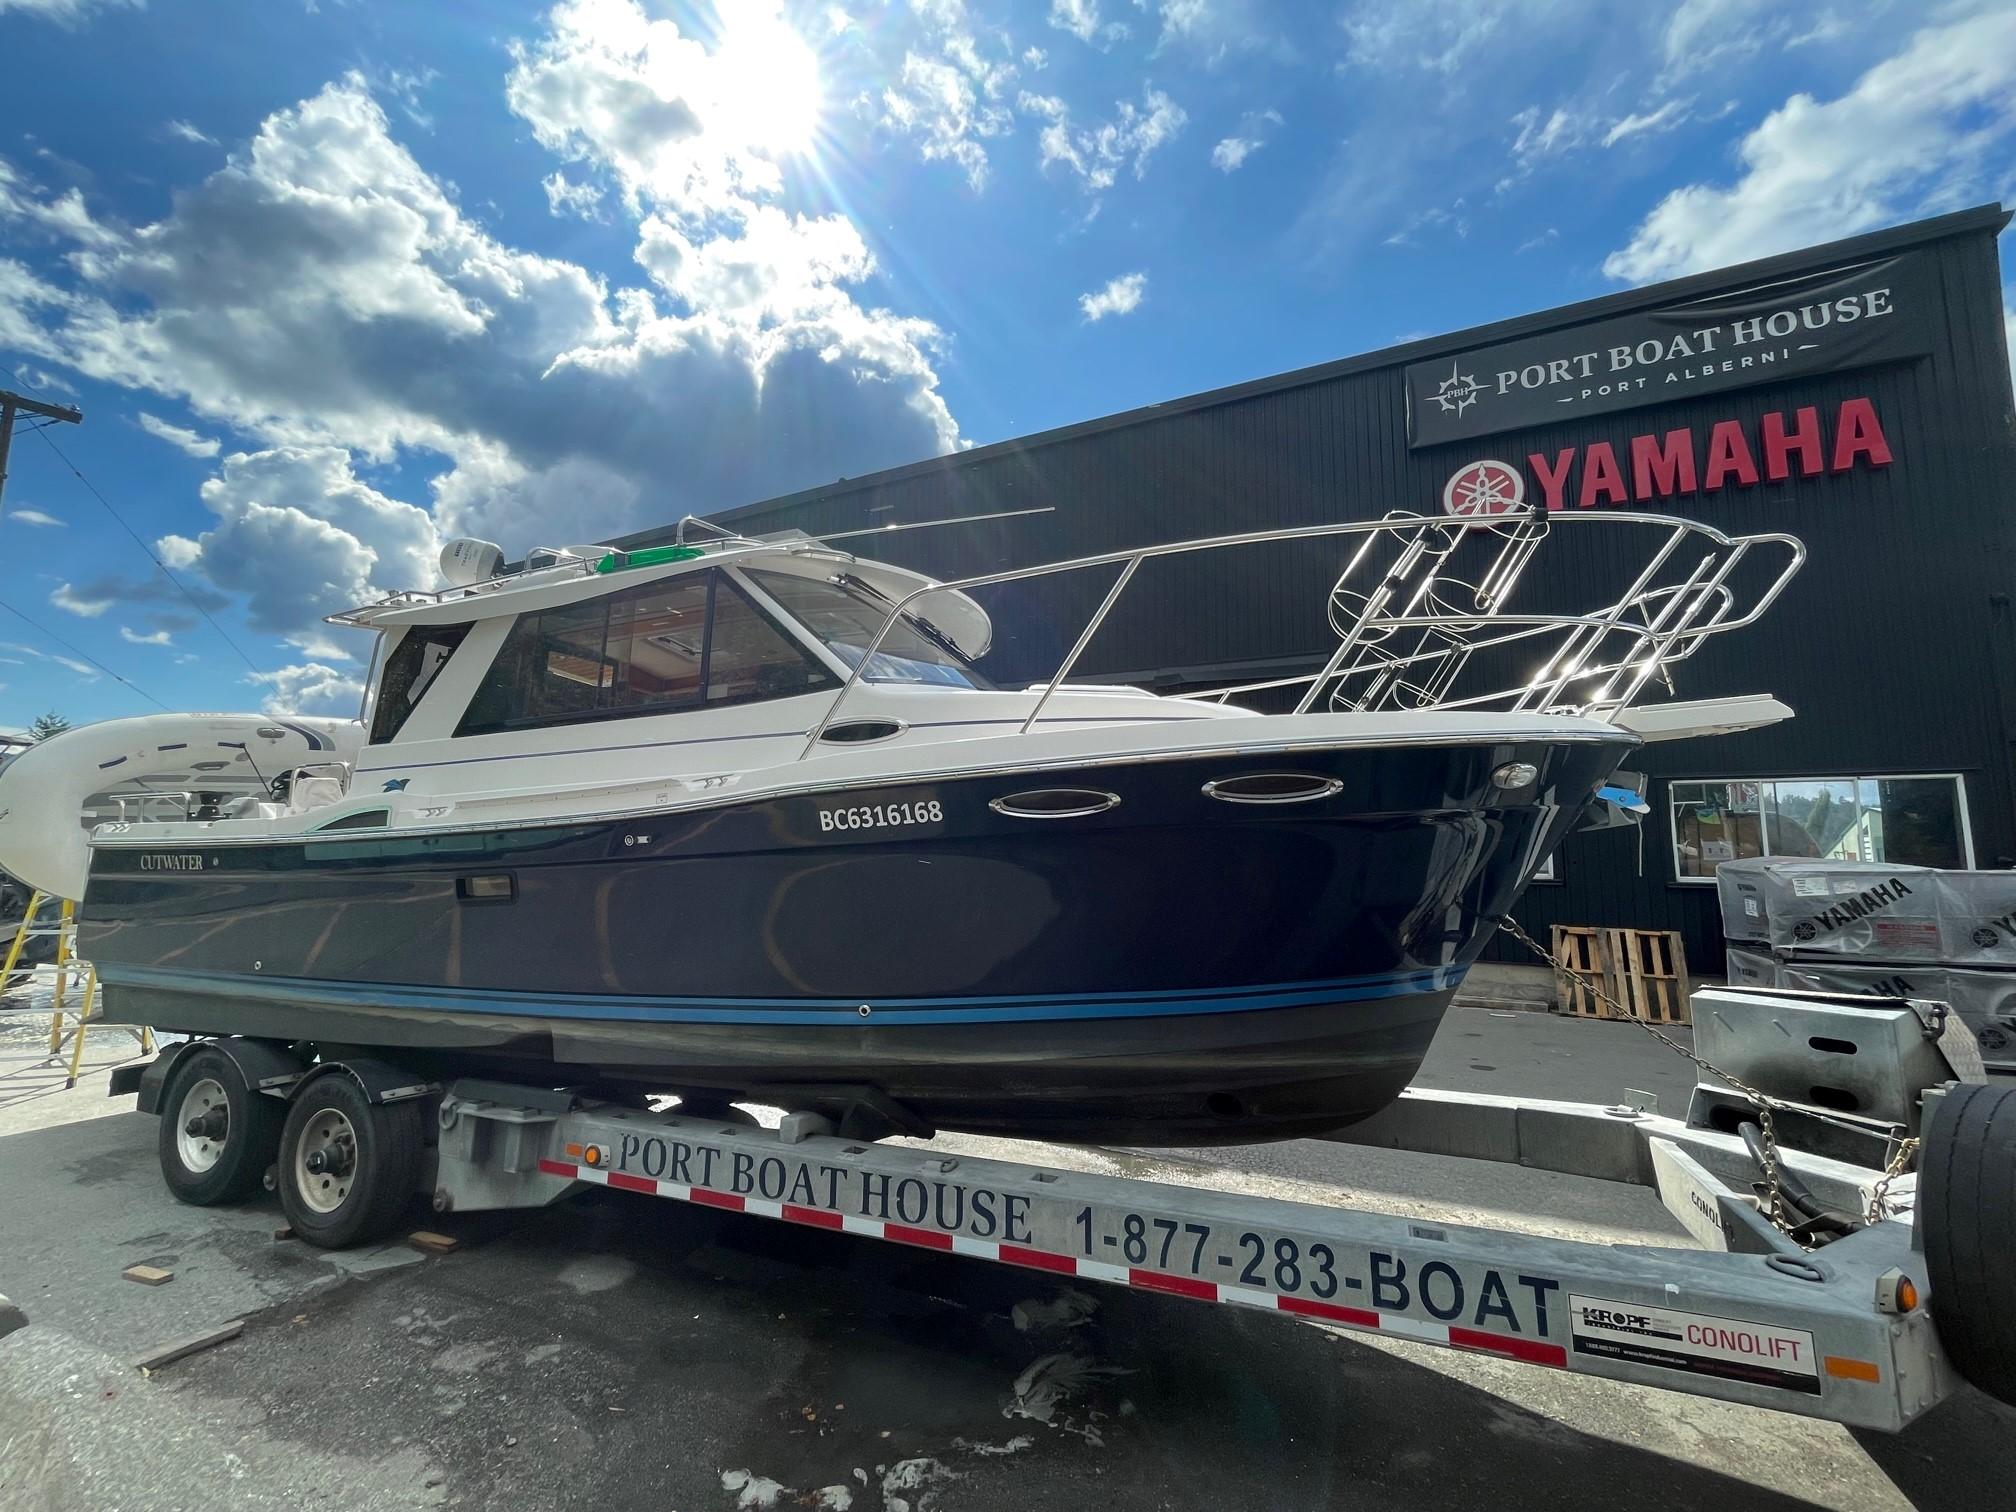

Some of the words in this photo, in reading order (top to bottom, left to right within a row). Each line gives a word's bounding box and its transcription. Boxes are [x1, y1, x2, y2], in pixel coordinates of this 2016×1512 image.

[1496, 352, 1598, 395] PORT
[1608, 326, 1721, 372] BOAT
[1733, 289, 1893, 345] HOUSE
[1447, 386, 1469, 399] PBH
[1581, 378, 1647, 400] PORT
[1665, 349, 1790, 385] ALBERNI
[1528, 397, 1893, 511] YAMAHA
[820, 801, 943, 831] BC6316168
[140, 854, 203, 870] CUTWATER
[1815, 878, 1912, 930] YAMAHA
[618, 1133, 720, 1187] PORT
[732, 1152, 849, 1211] BOAT
[861, 1172, 1032, 1244] HOUSE
[1076, 1207, 1559, 1336] 1-877-283-BOAT
[1687, 1324, 1801, 1362] CONOLIFT
